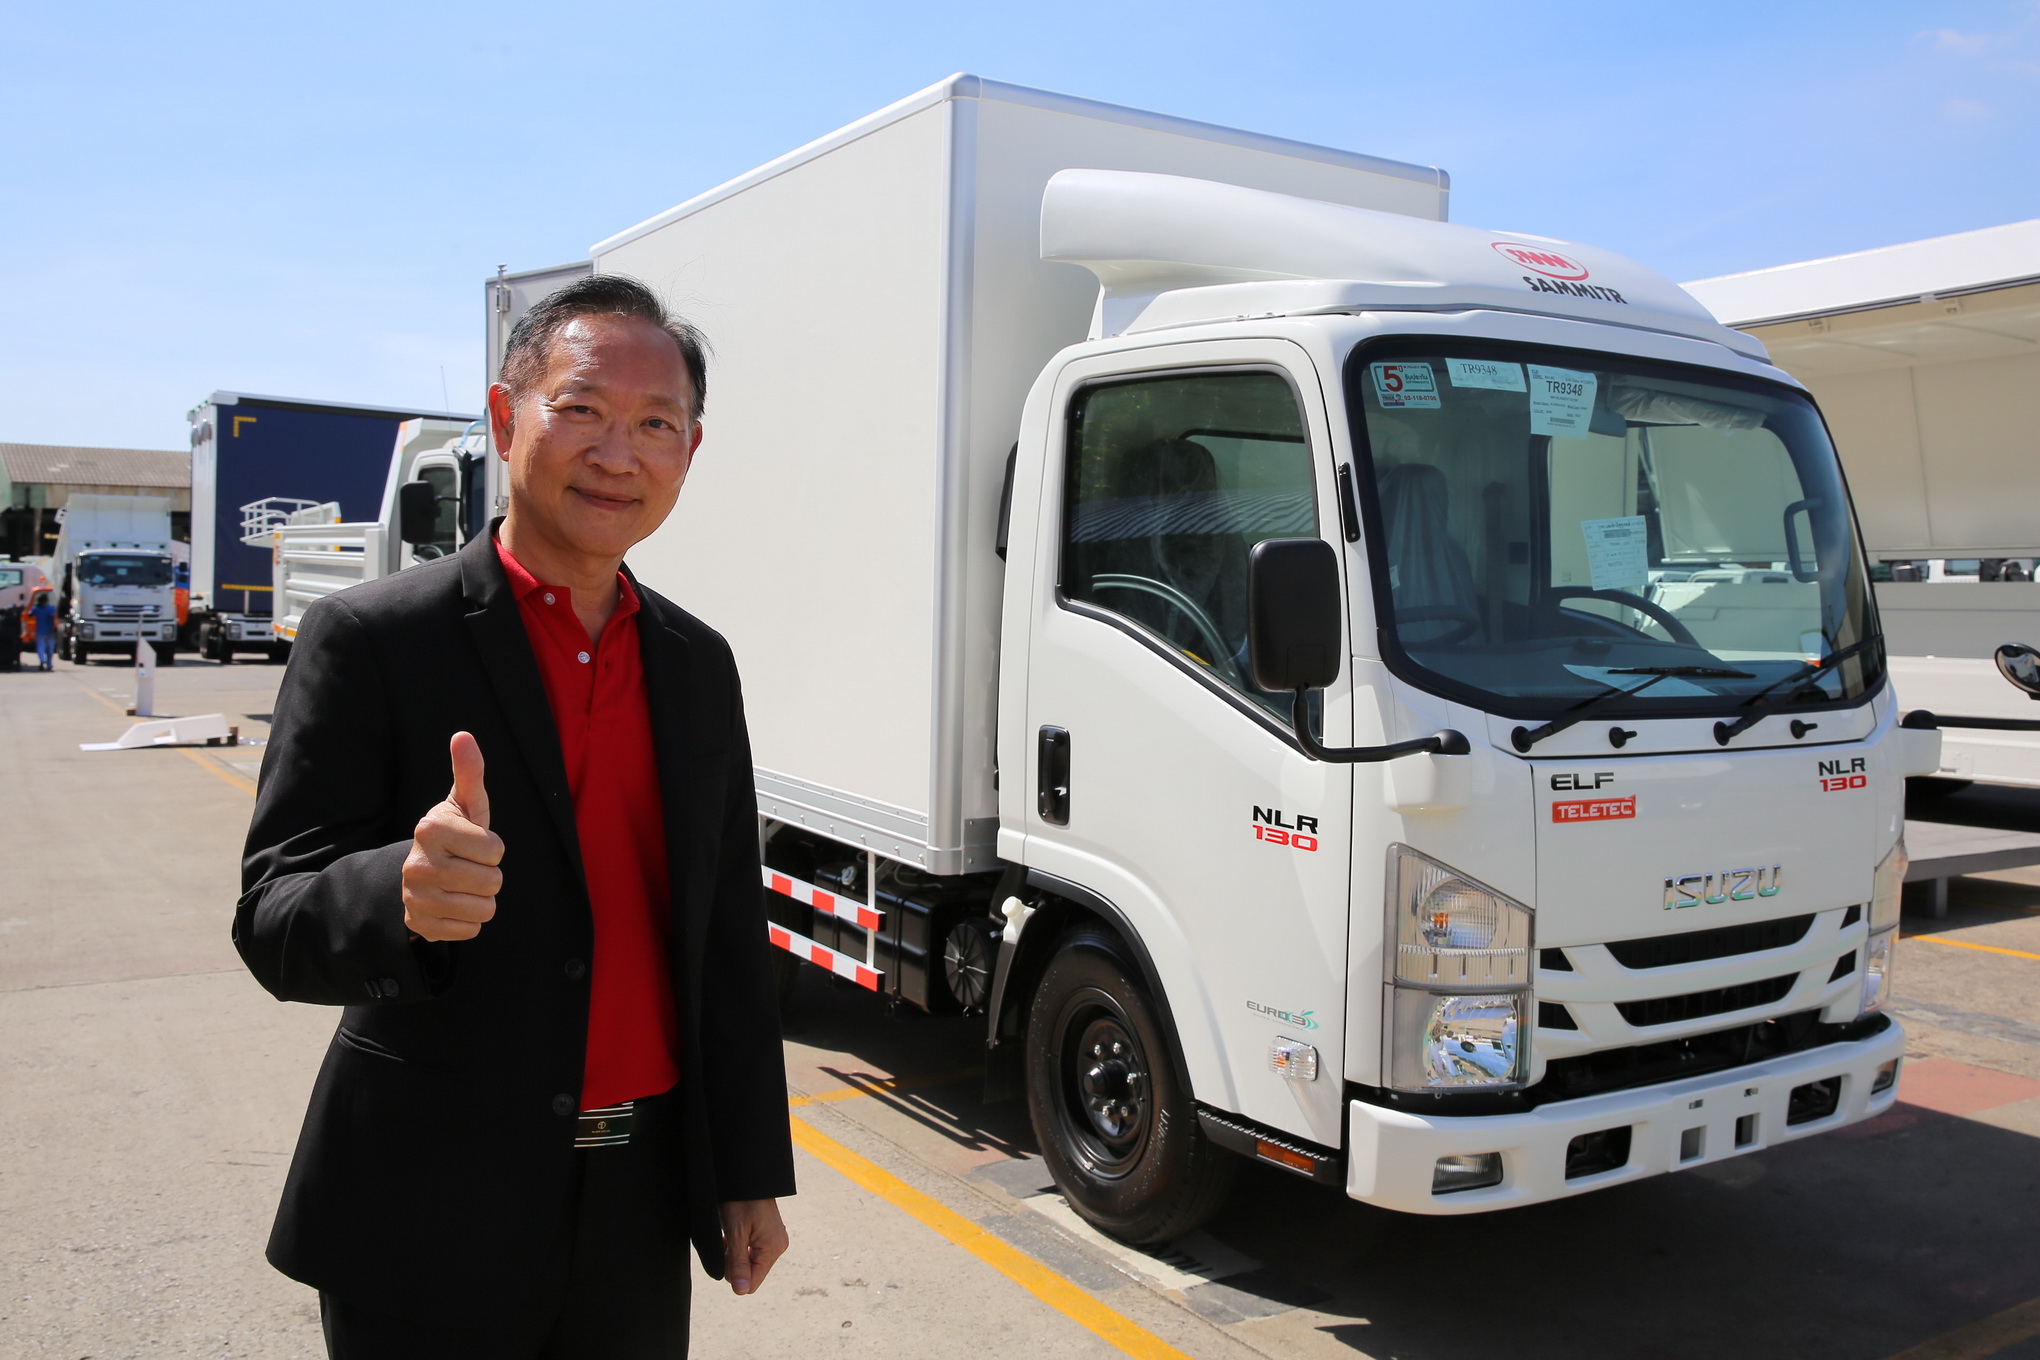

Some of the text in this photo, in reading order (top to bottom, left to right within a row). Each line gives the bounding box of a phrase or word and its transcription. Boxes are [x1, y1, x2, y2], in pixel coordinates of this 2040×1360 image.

[1522, 276, 1628, 304] SAMMITR
[1383, 366, 1403, 392] 5
[1460, 363, 1498, 376] TR9348
[1546, 380, 1583, 396] TR9348
[1817, 757, 1866, 776] NLR
[1550, 772, 1614, 791] ELF
[1819, 775, 1867, 792] 130
[1557, 801, 1633, 819] TELETEC
[1252, 805, 1318, 835] NLR
[1252, 824, 1318, 852] 130
[1663, 863, 1782, 911] ISUZU
